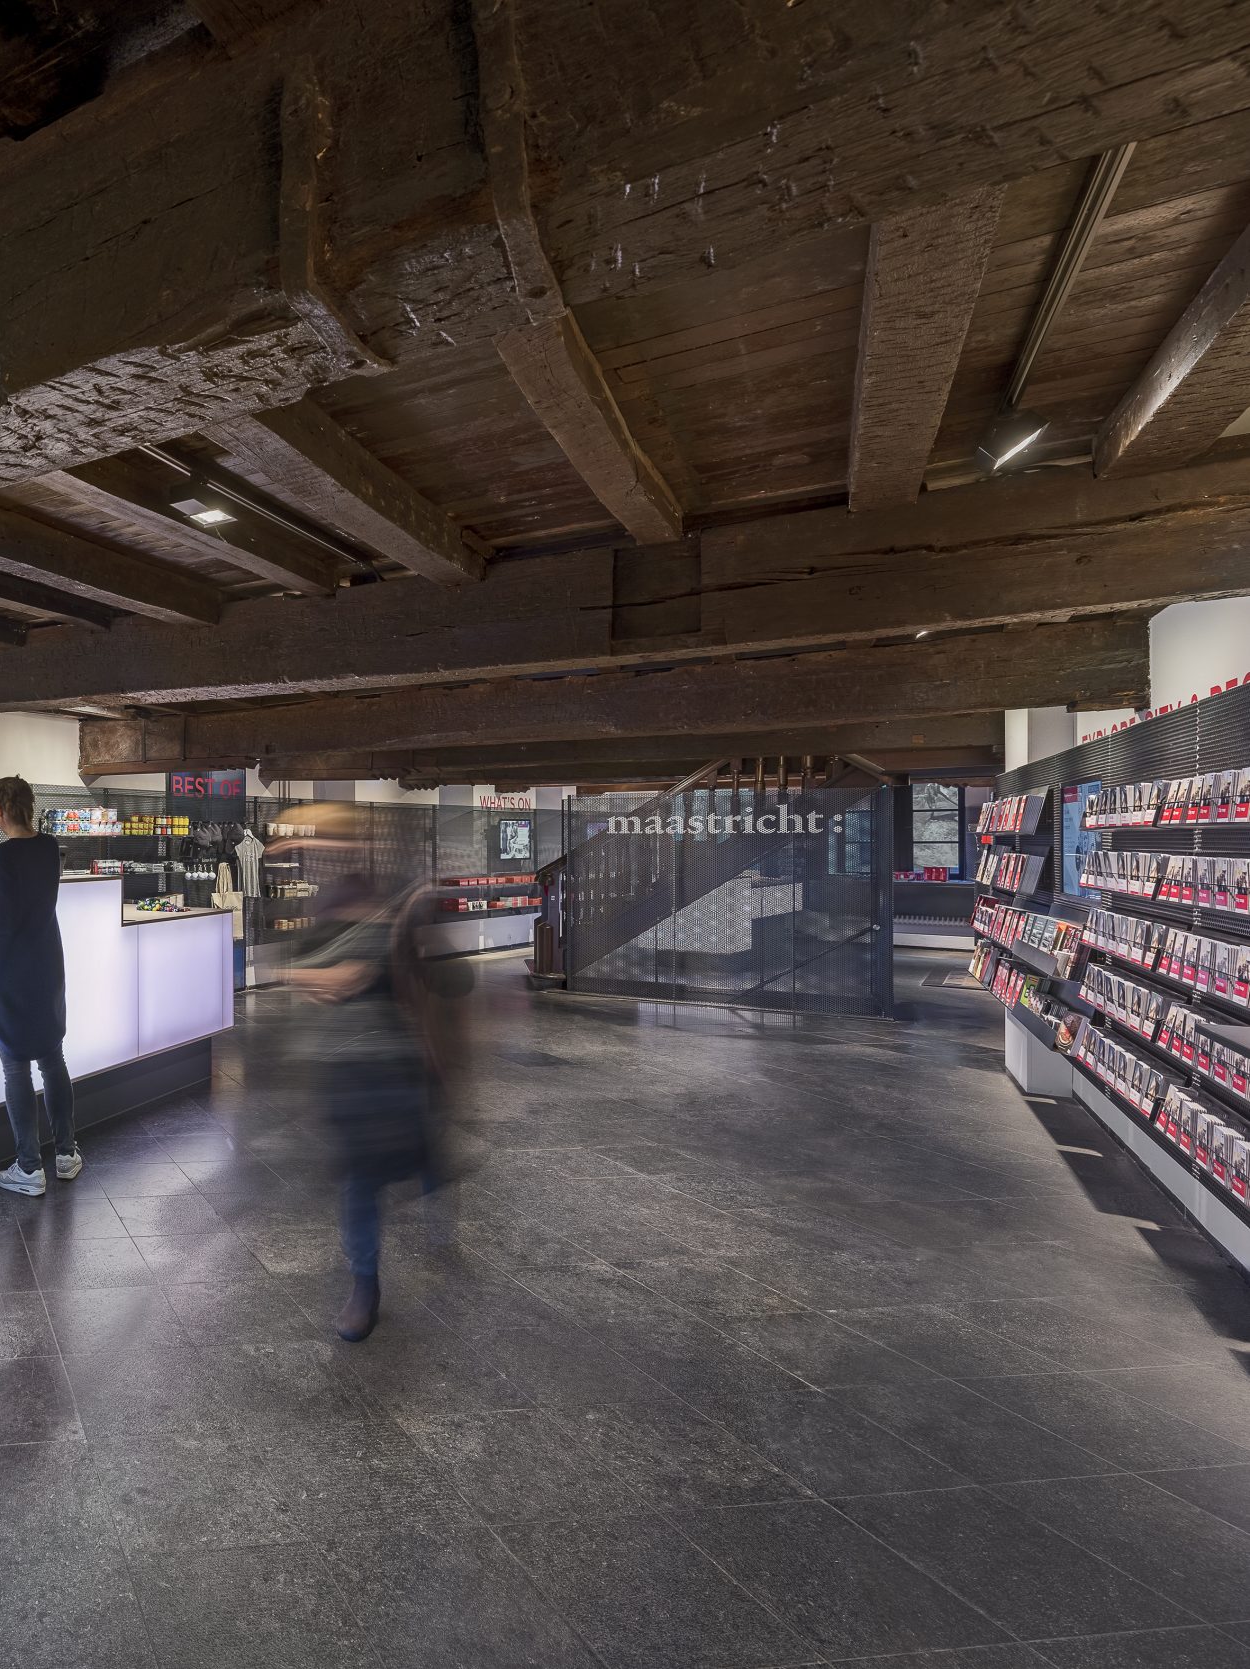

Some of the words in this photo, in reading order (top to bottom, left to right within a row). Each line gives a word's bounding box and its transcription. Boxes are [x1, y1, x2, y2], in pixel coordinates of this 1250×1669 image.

[173, 775, 216, 798] BEST
[220, 779, 243, 800] OF
[479, 796, 515, 810] WHAT'S
[518, 798, 531, 811] ON
